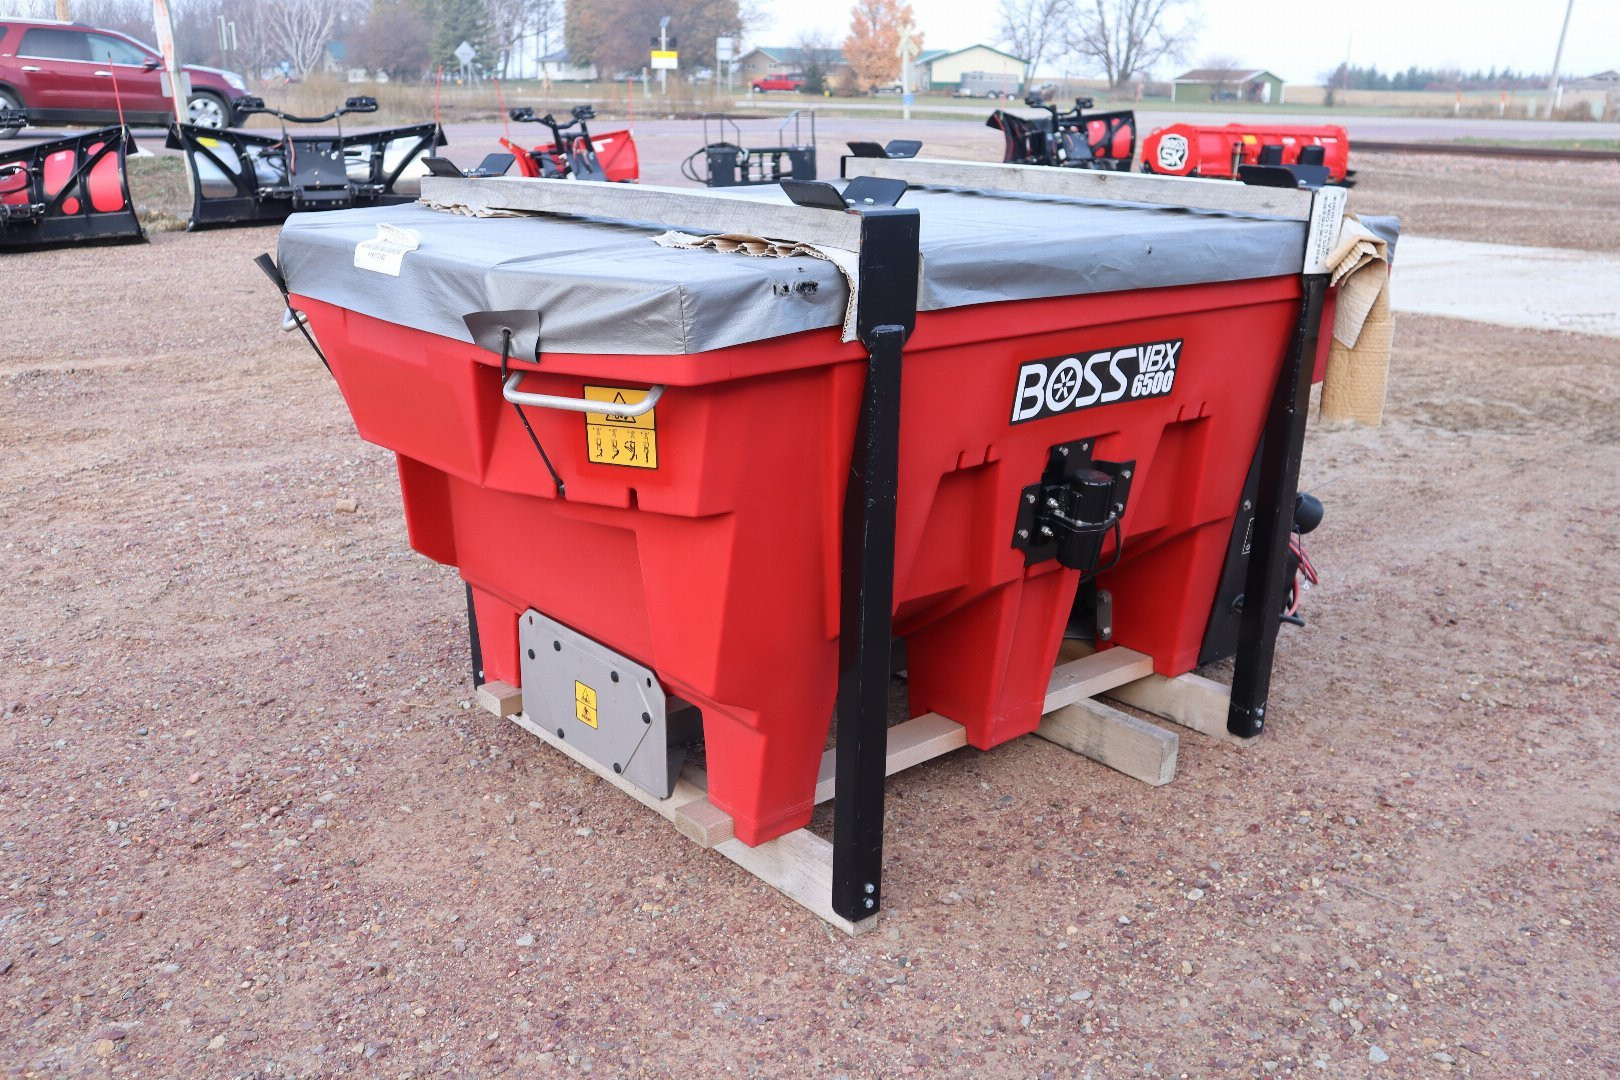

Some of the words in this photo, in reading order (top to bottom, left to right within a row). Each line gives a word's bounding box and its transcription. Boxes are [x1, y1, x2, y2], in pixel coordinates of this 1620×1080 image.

[1161, 149, 1185, 166] SK
[1012, 348, 1137, 422] BOSS
[1138, 341, 1182, 373] VBX
[1131, 369, 1174, 398] 6500
